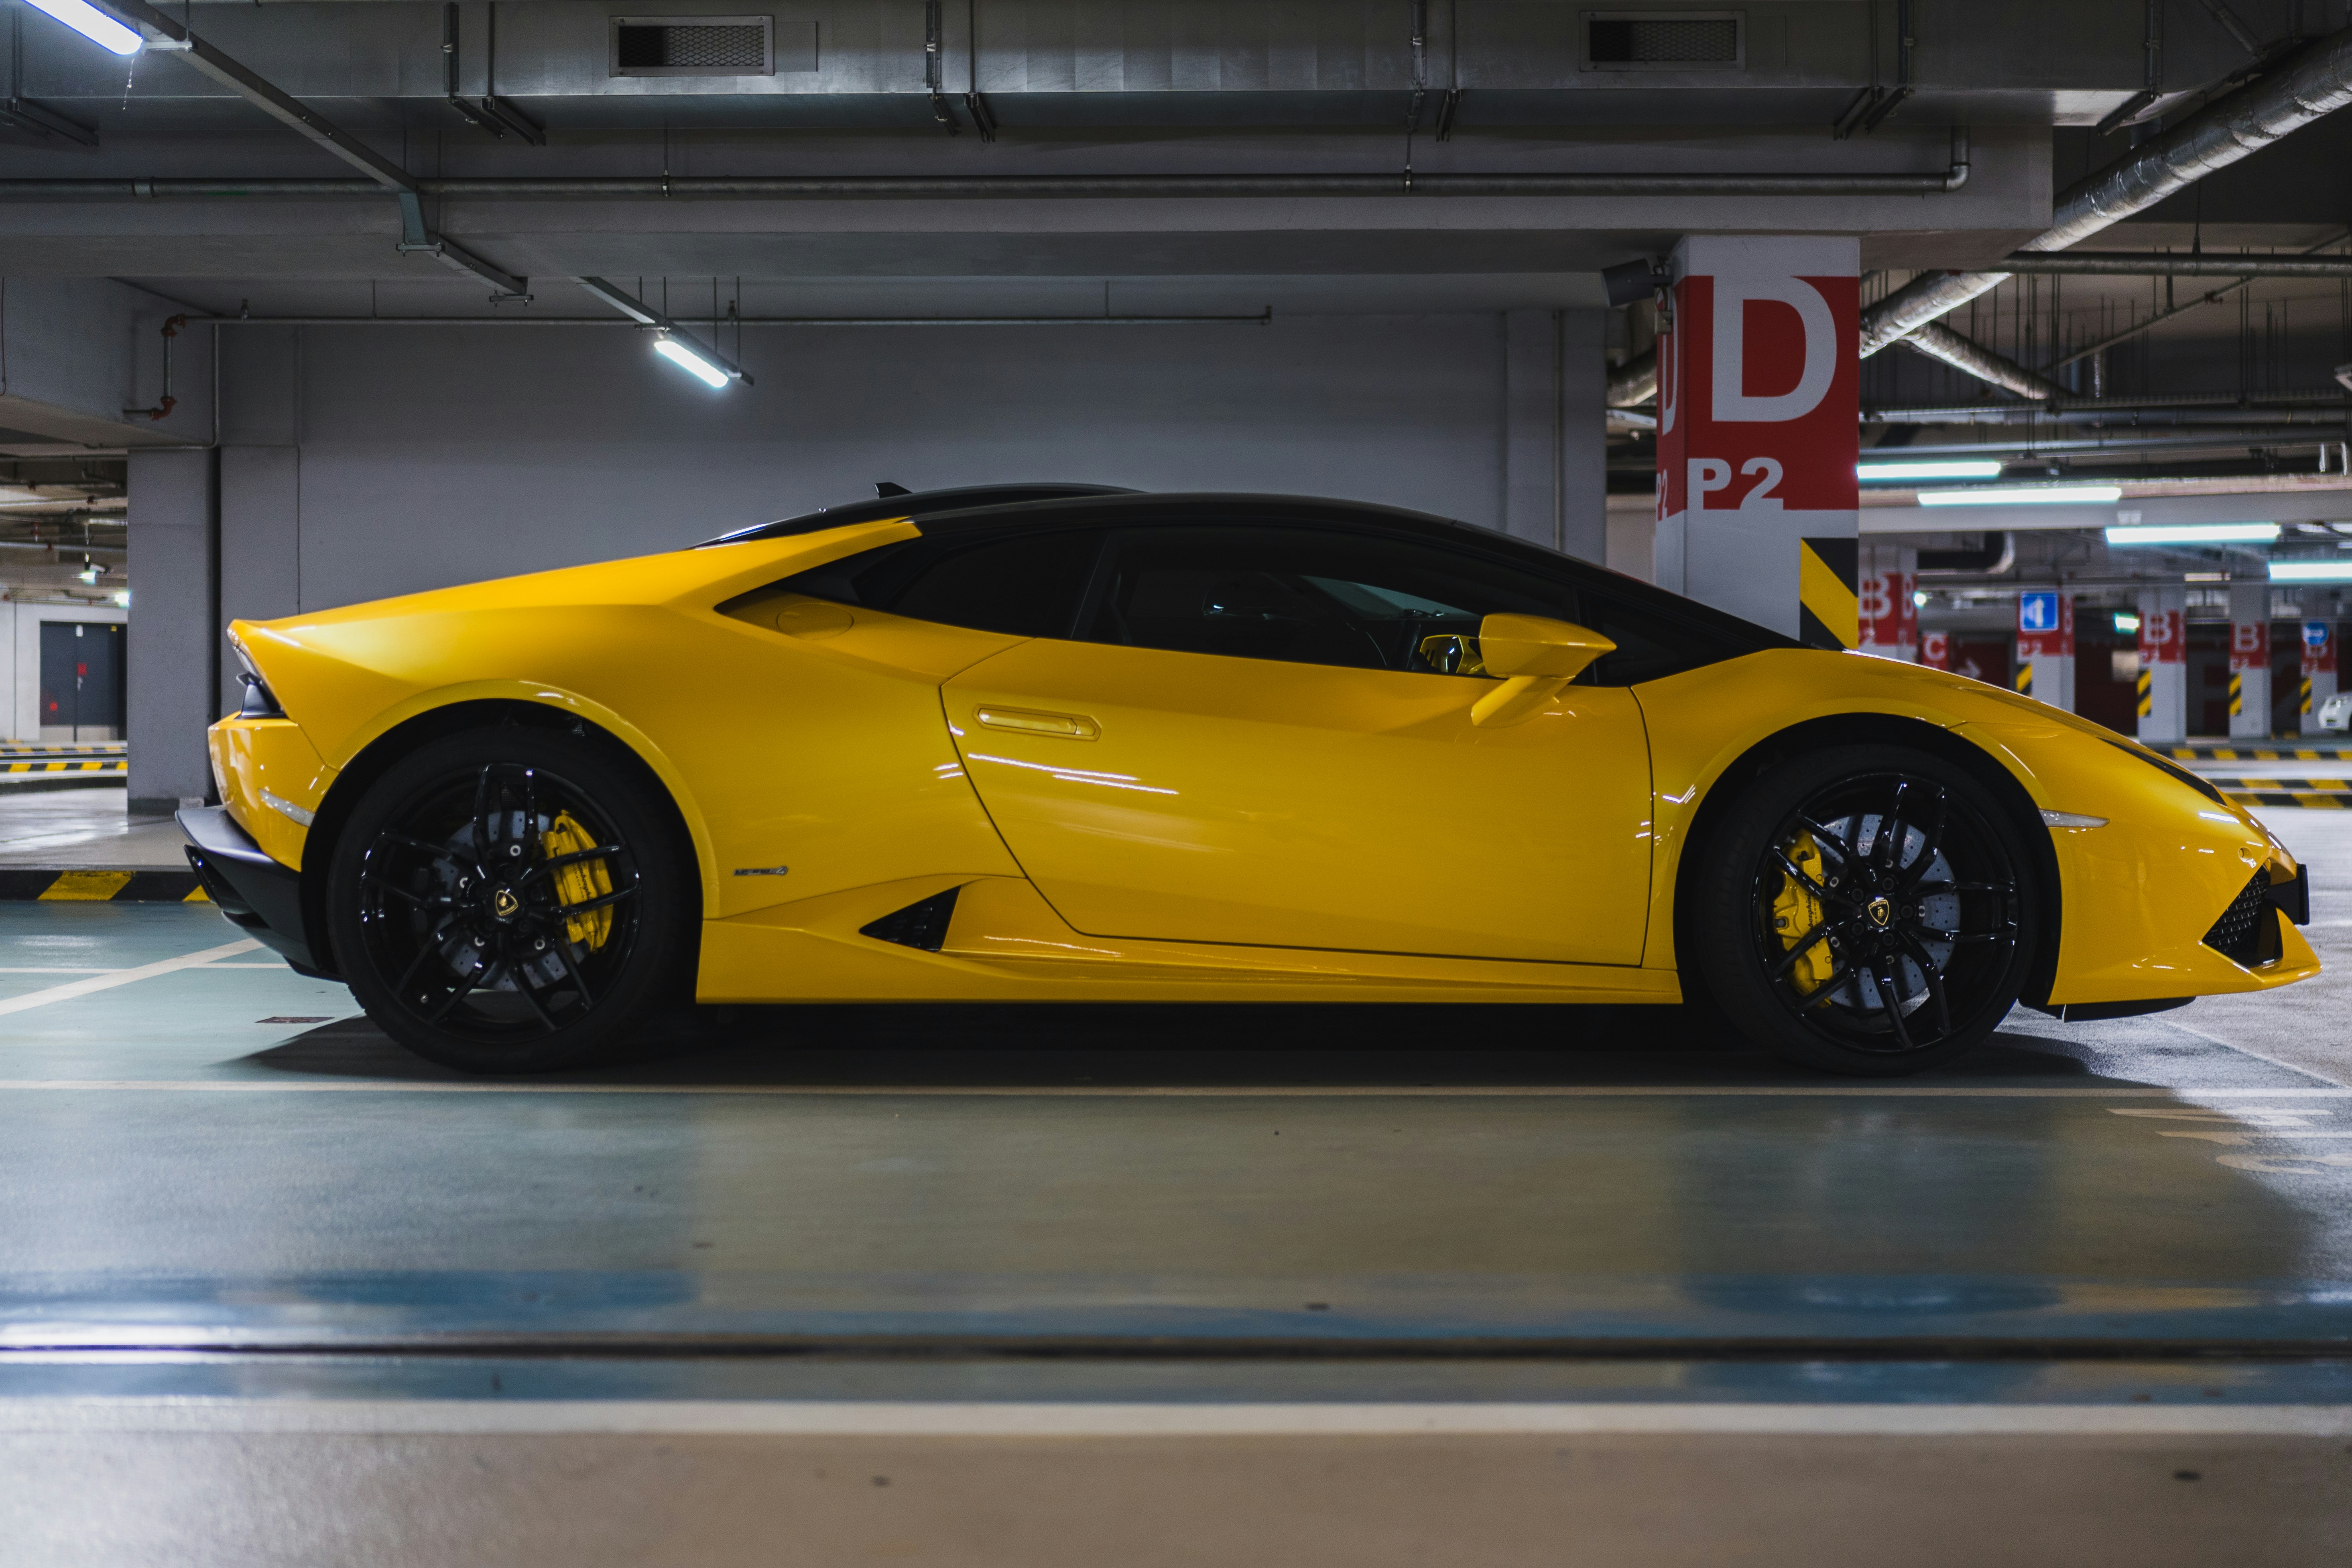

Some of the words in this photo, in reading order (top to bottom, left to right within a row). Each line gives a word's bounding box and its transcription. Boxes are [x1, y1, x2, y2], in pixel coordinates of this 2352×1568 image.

[1712, 275, 1837, 422] D
[1656, 469, 1668, 521] P2
[1687, 457, 1784, 510] P2
[1858, 573, 1892, 619] B
[1925, 632, 1946, 661] C
[2144, 610, 2172, 644] B
[2235, 622, 2259, 652] B
